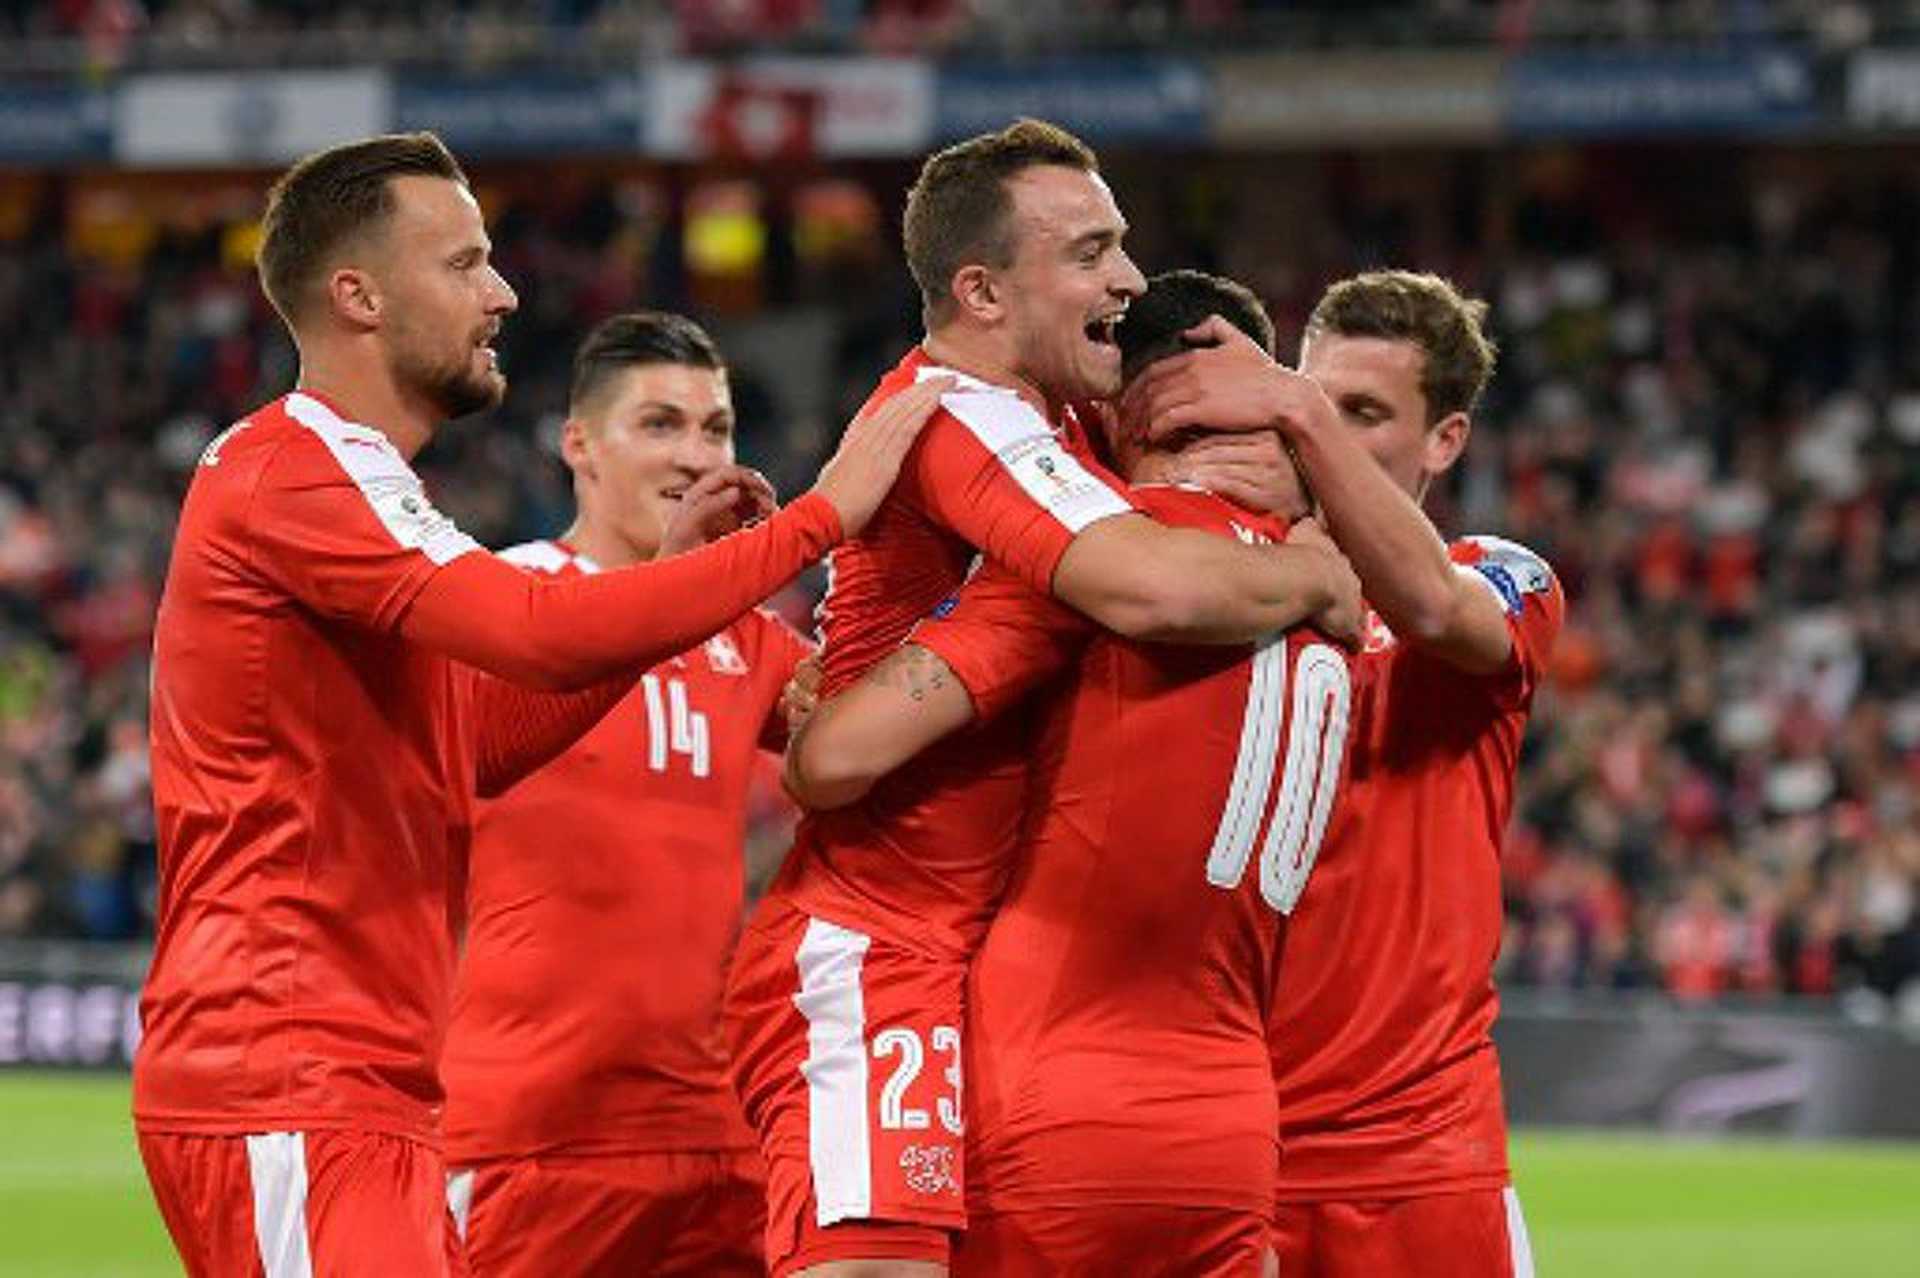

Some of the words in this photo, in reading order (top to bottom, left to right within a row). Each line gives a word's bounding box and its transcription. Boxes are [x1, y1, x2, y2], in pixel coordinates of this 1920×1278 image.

[640, 675, 711, 777] 14
[1206, 638, 1352, 915] 10
[873, 1025, 964, 1136] 23
